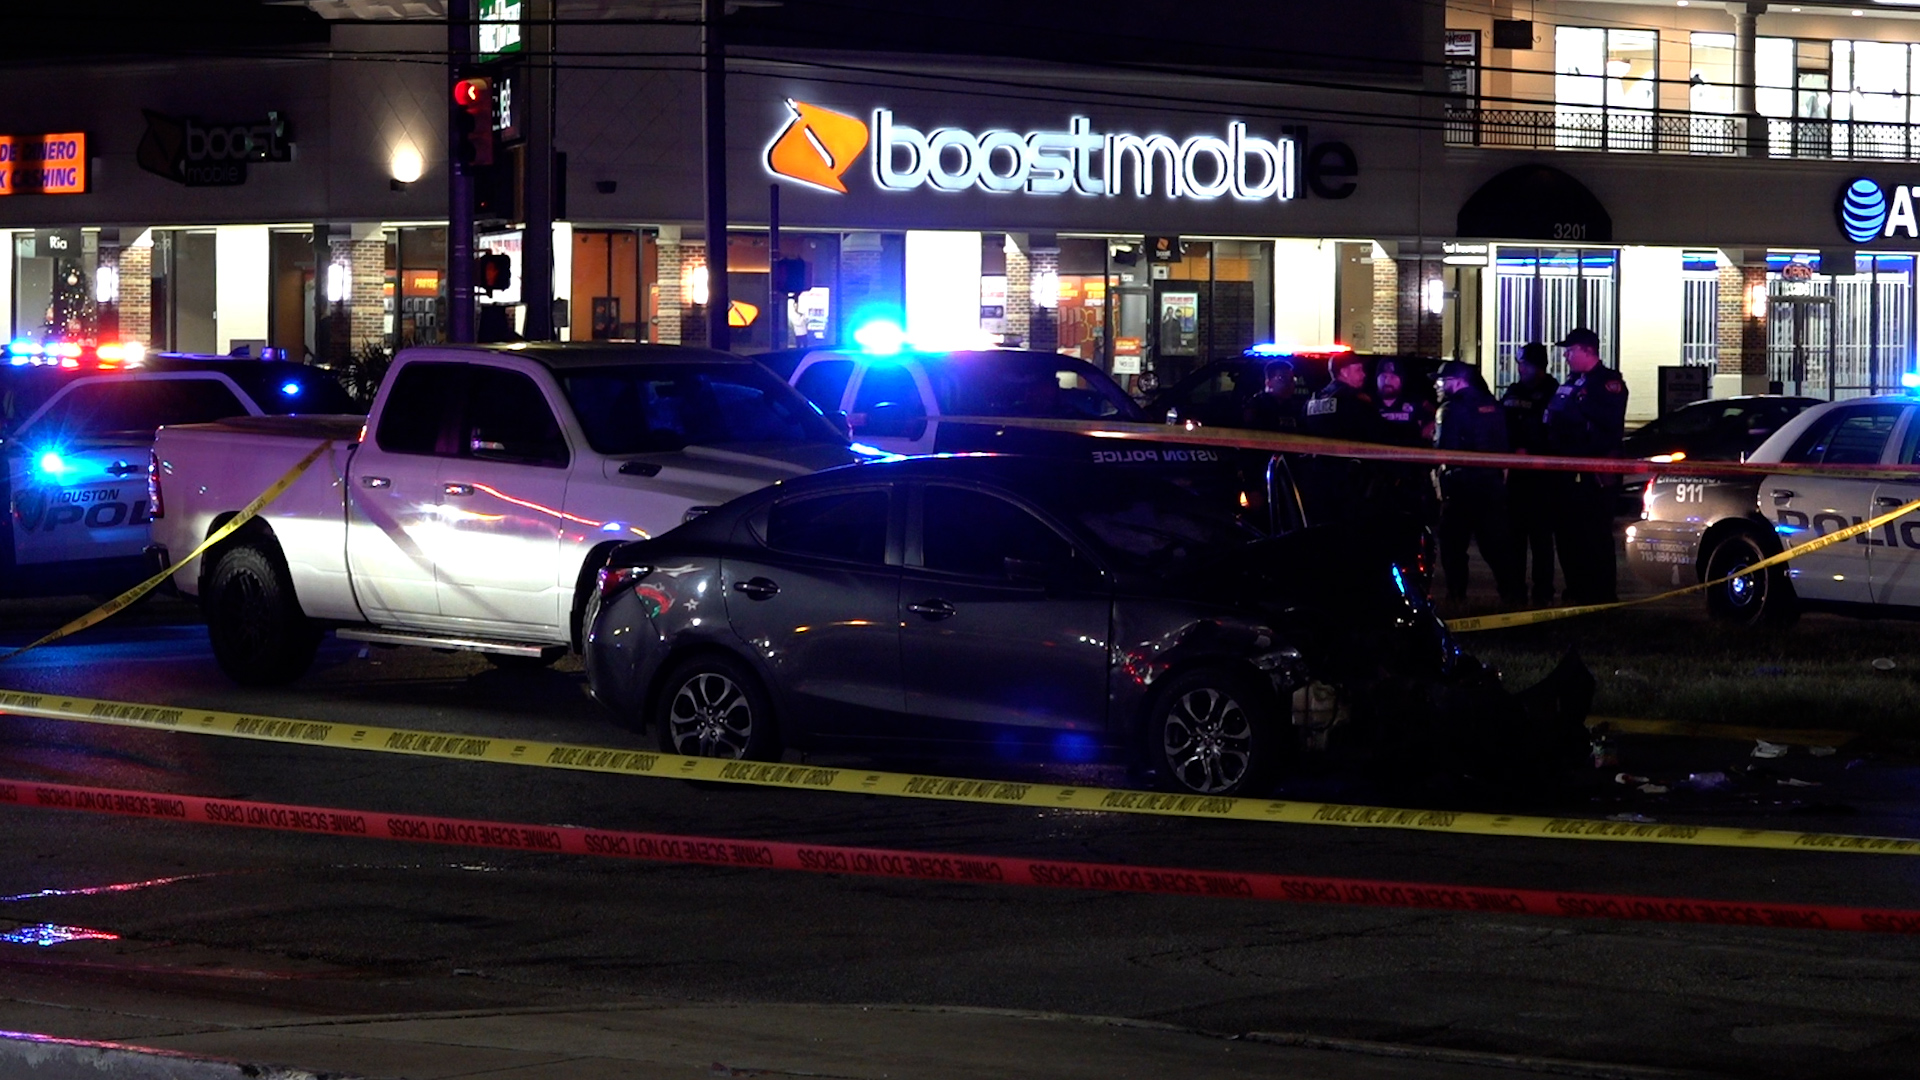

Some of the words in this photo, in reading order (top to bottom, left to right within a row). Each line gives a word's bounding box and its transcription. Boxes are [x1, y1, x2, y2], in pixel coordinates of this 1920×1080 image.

[186, 113, 283, 161] boost
[187, 166, 239, 183] mobile
[1553, 222, 1586, 240] 3201
[49, 236, 68, 250] Ria
[1308, 400, 1335, 413] POLICE
[51, 489, 121, 504] HOUSTON
[1675, 483, 1704, 503] 911
[89, 703, 119, 717] POLICE
[114, 705, 134, 719] LINE
[128, 707, 145, 720] DO
[139, 708, 160, 721] NOT
[154, 709, 183, 724] CROSS
[232, 717, 264, 734] POLICE
[257, 719, 280, 736] LINE
[274, 721, 291, 737] DO
[285, 722, 307, 738] NOT
[301, 723, 332, 741] CROSS
[384, 731, 417, 749] POLICE
[412, 734, 435, 751] LINE
[429, 736, 447, 752] DO
[441, 737, 464, 753] NOT
[458, 738, 490, 756] CROSS
[546, 746, 581, 764] POLICE
[575, 749, 601, 766] LINE
[593, 750, 613, 767] DO
[606, 751, 631, 769] NOT
[625, 753, 660, 771] CROSS
[718, 761, 756, 779] POLICE
[749, 764, 777, 781] LINE
[769, 766, 790, 782] DO
[783, 767, 809, 783] NOT
[802, 768, 839, 786] CROSS
[36, 787, 72, 807] CROSS
[902, 776, 942, 793] POLICE
[935, 778, 965, 795] LINE
[956, 780, 978, 796] DO
[971, 781, 998, 797] NOT
[992, 783, 1031, 800] CROSS
[74, 791, 95, 809] NOT
[96, 793, 112, 811] DO
[114, 794, 149, 814] SCENE
[150, 798, 184, 817] CRIME
[1100, 790, 1142, 807] POLICE
[1136, 793, 1165, 809] LINE
[1159, 794, 1180, 810] DO
[1173, 795, 1202, 812] NOT
[1196, 797, 1237, 814] CROSS
[204, 803, 244, 823] CROSS
[246, 806, 269, 825] NOT
[270, 808, 288, 826] DO
[289, 810, 328, 830] SCENE
[328, 813, 366, 833] CRIME
[1311, 804, 1356, 821] POLICE
[1350, 807, 1381, 822] LINE
[1374, 808, 1397, 823] DO
[1390, 809, 1421, 825] NOT
[1415, 811, 1461, 827] CROSS
[387, 818, 430, 839] CROSS
[432, 822, 457, 841] NOT
[457, 824, 476, 842] DO
[477, 825, 520, 846] SCENE
[521, 829, 561, 849] CRIME
[584, 833, 630, 854] CROSS
[632, 837, 660, 857] NOT
[660, 839, 682, 858] DO
[682, 841, 729, 862] SCENE
[729, 844, 773, 865] CRIME
[797, 849, 848, 870] CROSS
[849, 852, 880, 872] NOT
[880, 854, 904, 874] DO
[904, 856, 954, 877] SCENE
[954, 859, 1003, 880] CRIME
[1029, 864, 1084, 885] CROSS
[1086, 868, 1119, 887] NOT
[1119, 870, 1144, 889] DO
[1147, 872, 1202, 892] SCENE
[1203, 875, 1254, 896] CRIME
